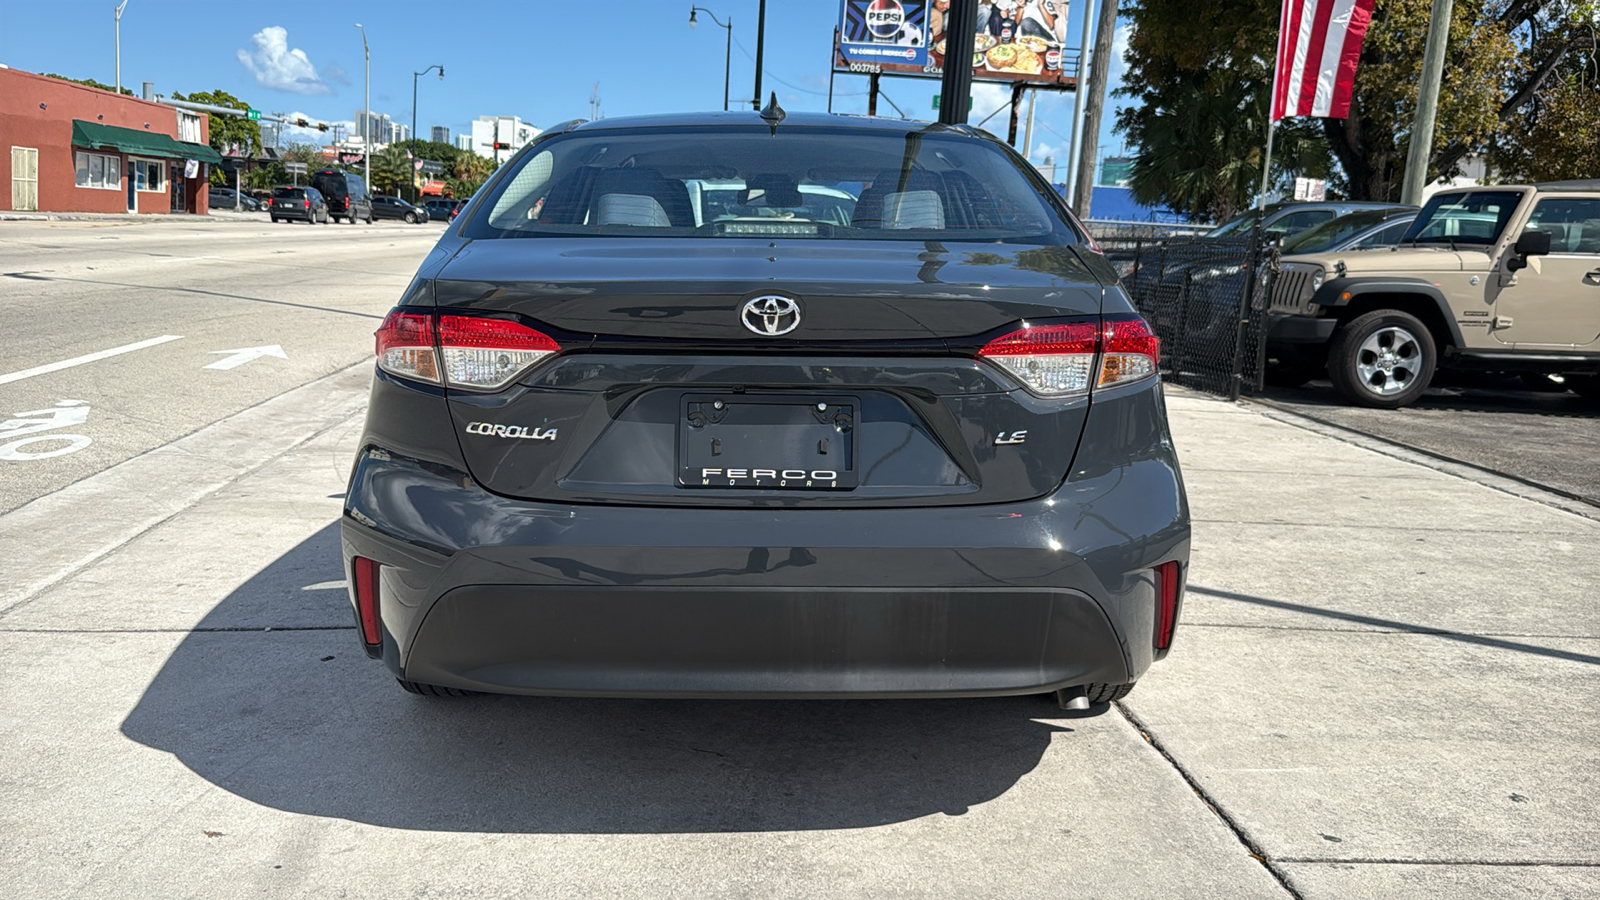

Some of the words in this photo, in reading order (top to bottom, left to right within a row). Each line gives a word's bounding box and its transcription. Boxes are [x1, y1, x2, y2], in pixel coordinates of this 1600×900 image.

[868, 12, 902, 22] PEPSI
[850, 63, 881, 73] 003785
[466, 422, 558, 440] COROLLA
[994, 430, 1028, 444] LE
[702, 468, 837, 480] FERCO
[702, 479, 837, 487] MOTORS
